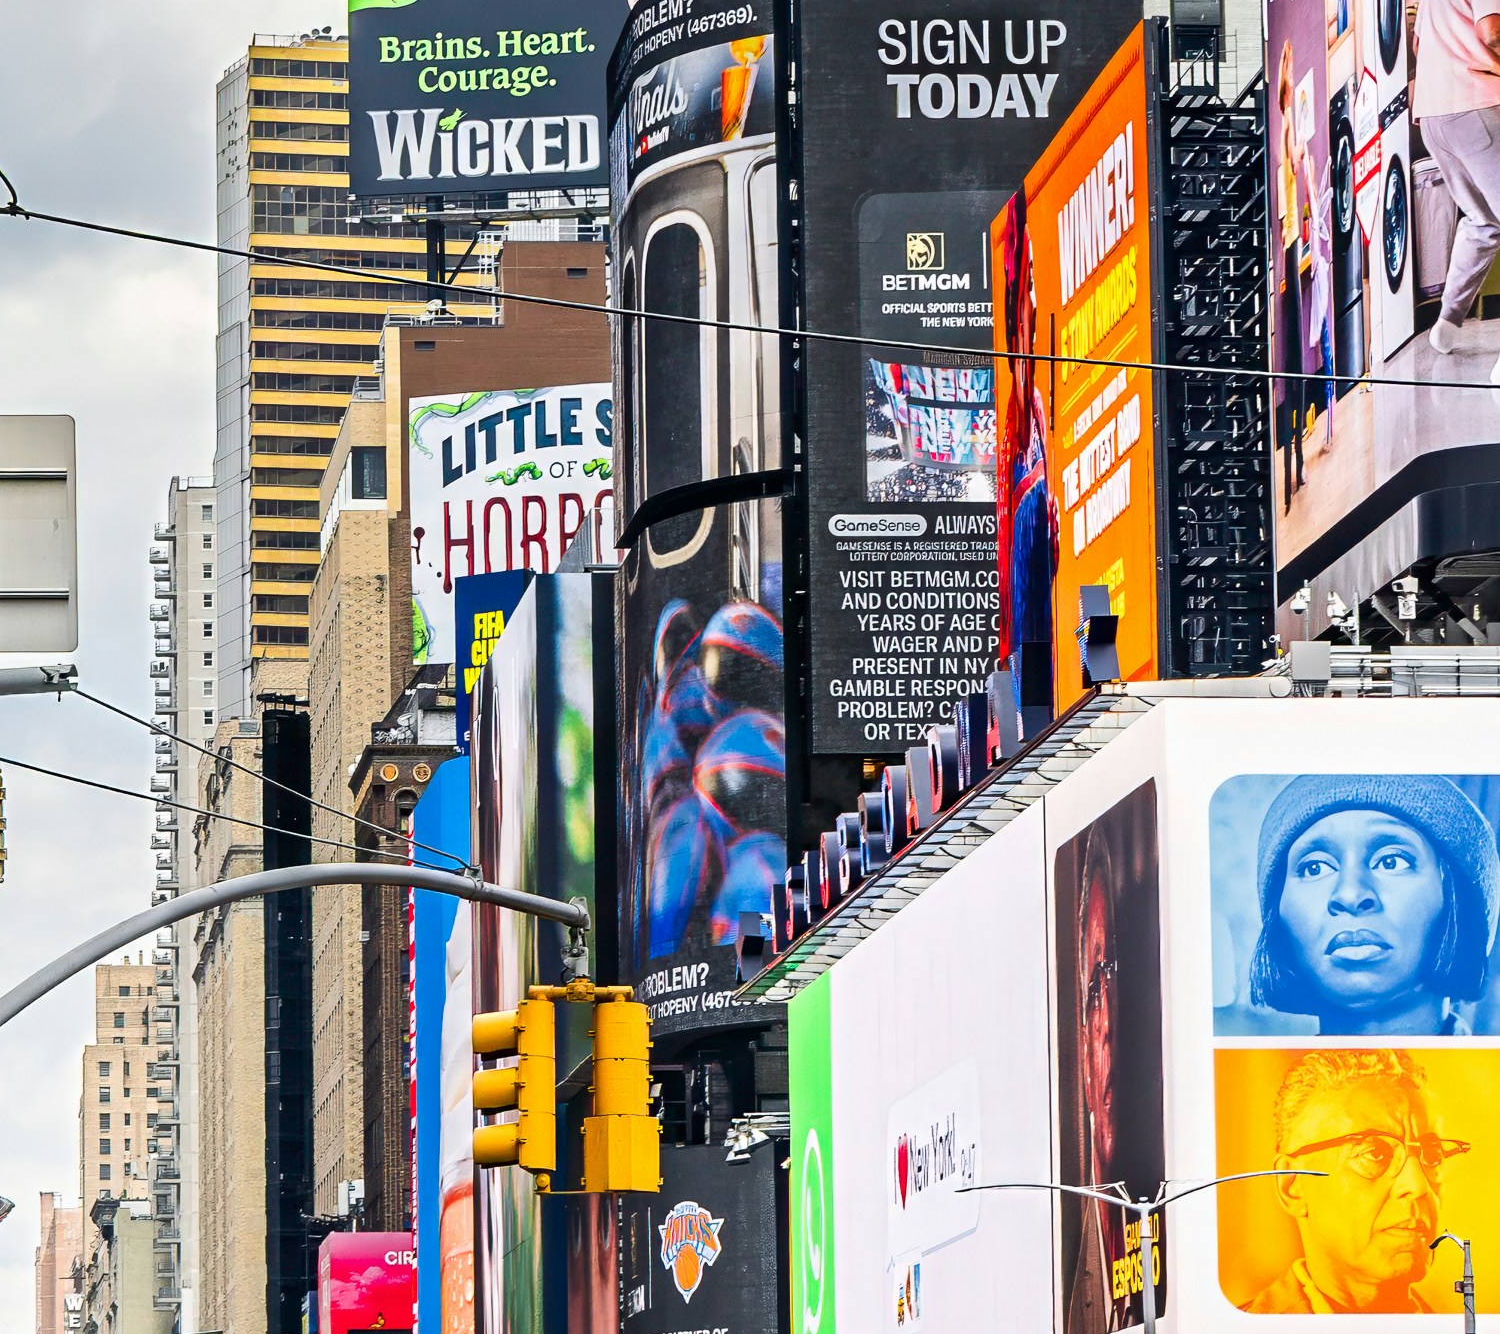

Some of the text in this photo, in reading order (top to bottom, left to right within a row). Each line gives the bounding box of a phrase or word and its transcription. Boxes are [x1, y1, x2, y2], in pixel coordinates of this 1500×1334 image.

[378, 28, 595, 63] Brains. Heart.
[878, 19, 1067, 64] SIGN UP
[418, 65, 557, 97] Courage.
[887, 74, 1059, 119] TODAY
[1057, 121, 1134, 307] WINNER!
[882, 274, 970, 291] BETMGM
[882, 303, 965, 314] OFFICIAL SPORTS
[921, 317, 964, 327] THE NEW
[441, 401, 583, 487] LITTLE
[549, 461, 578, 479] OF
[834, 514, 995, 534] GameSense ALWAYS
[839, 571, 885, 587] VISIT
[842, 592, 1000, 610] AND CONDITIONS
[857, 614, 986, 631] YEARS OF AGE
[872, 636, 982, 653] WAGER AND
[852, 658, 989, 675] PRESENT IN NY
[830, 680, 905, 696] GAMBLE
[838, 701, 934, 718] PROBLEM?
[864, 723, 890, 740] OR
